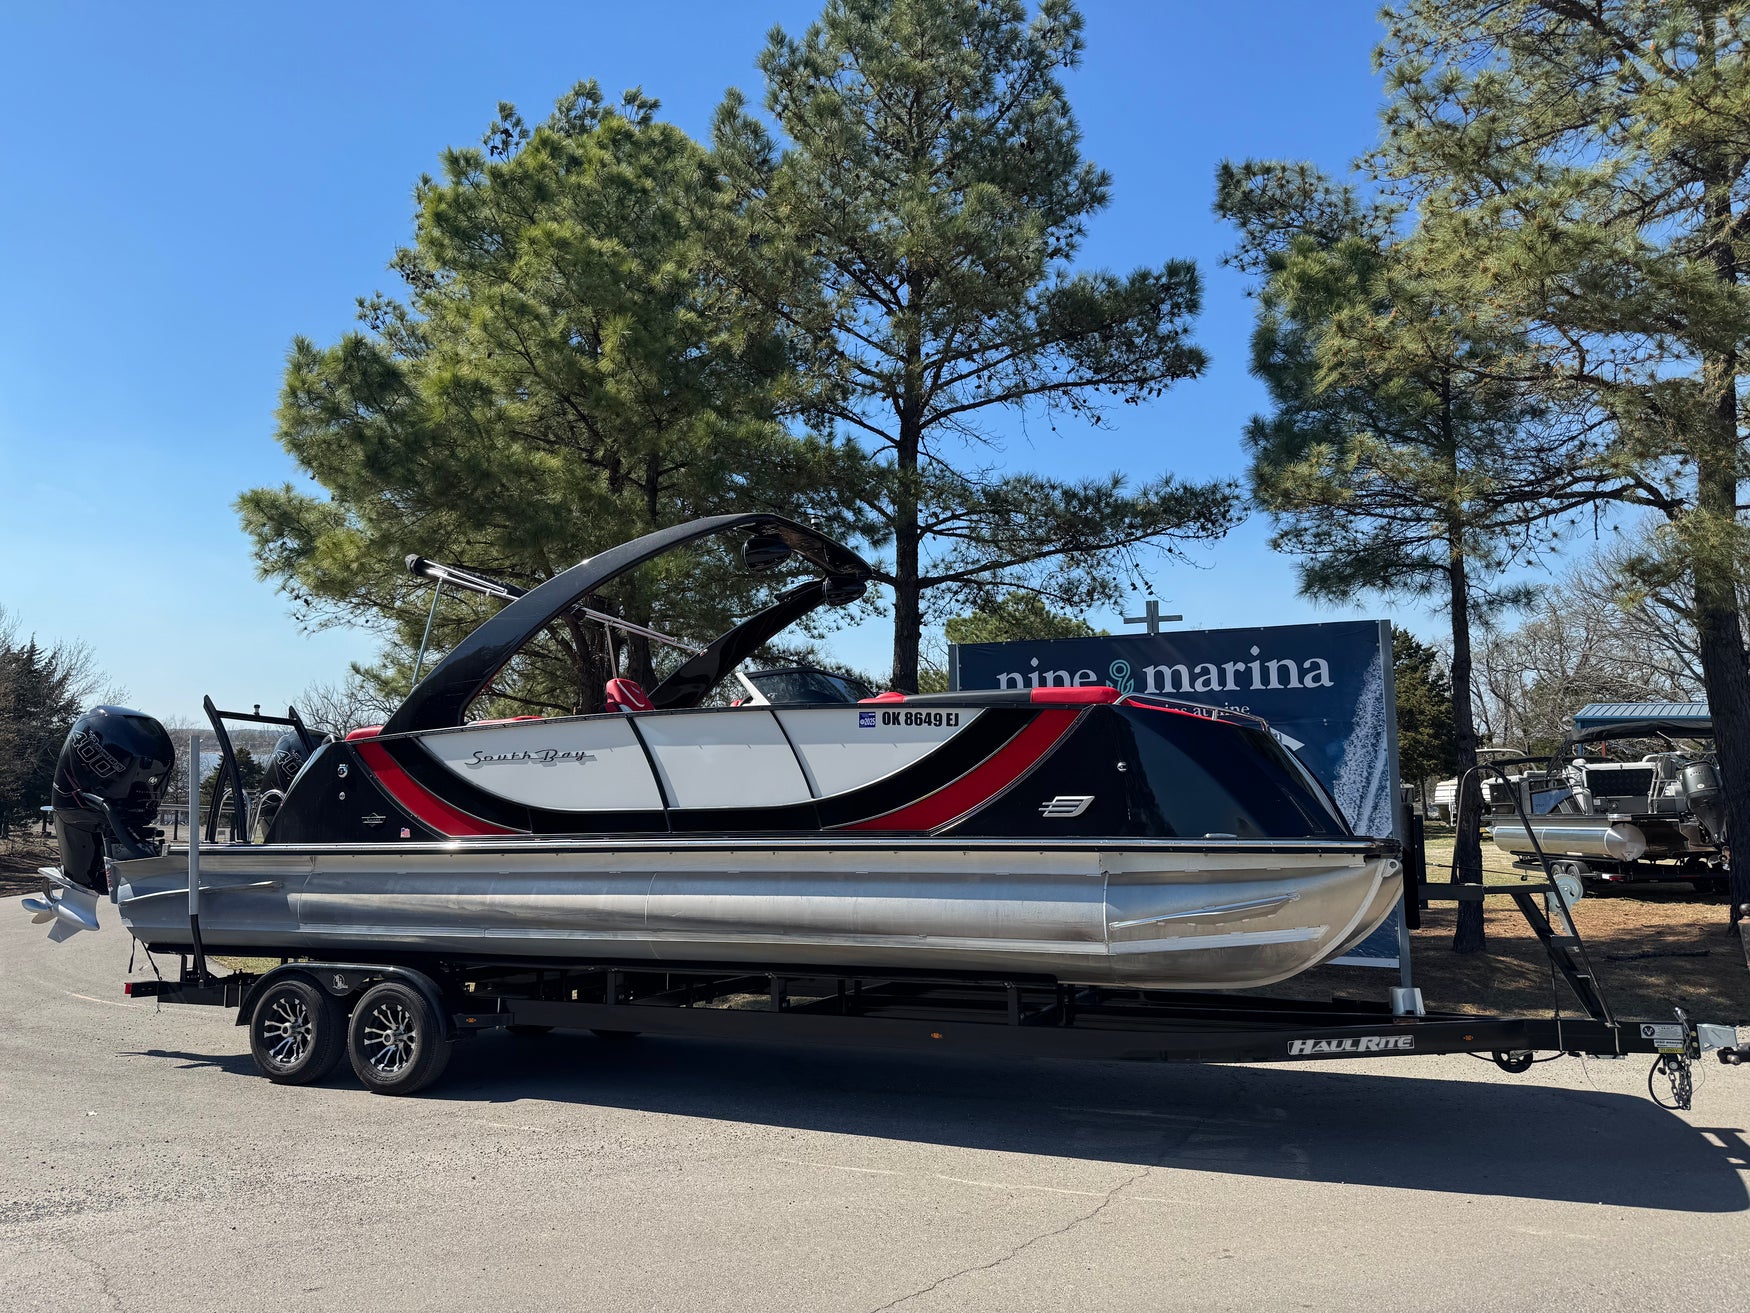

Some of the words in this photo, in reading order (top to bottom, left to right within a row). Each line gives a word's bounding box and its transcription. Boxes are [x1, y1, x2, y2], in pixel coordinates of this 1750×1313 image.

[1143, 645, 1335, 694] marina
[882, 711, 901, 726] OK
[904, 711, 943, 727] 8649
[946, 713, 959, 727] EJ
[70, 729, 118, 778] 400
[464, 750, 531, 765] South
[534, 748, 586, 763] Bay
